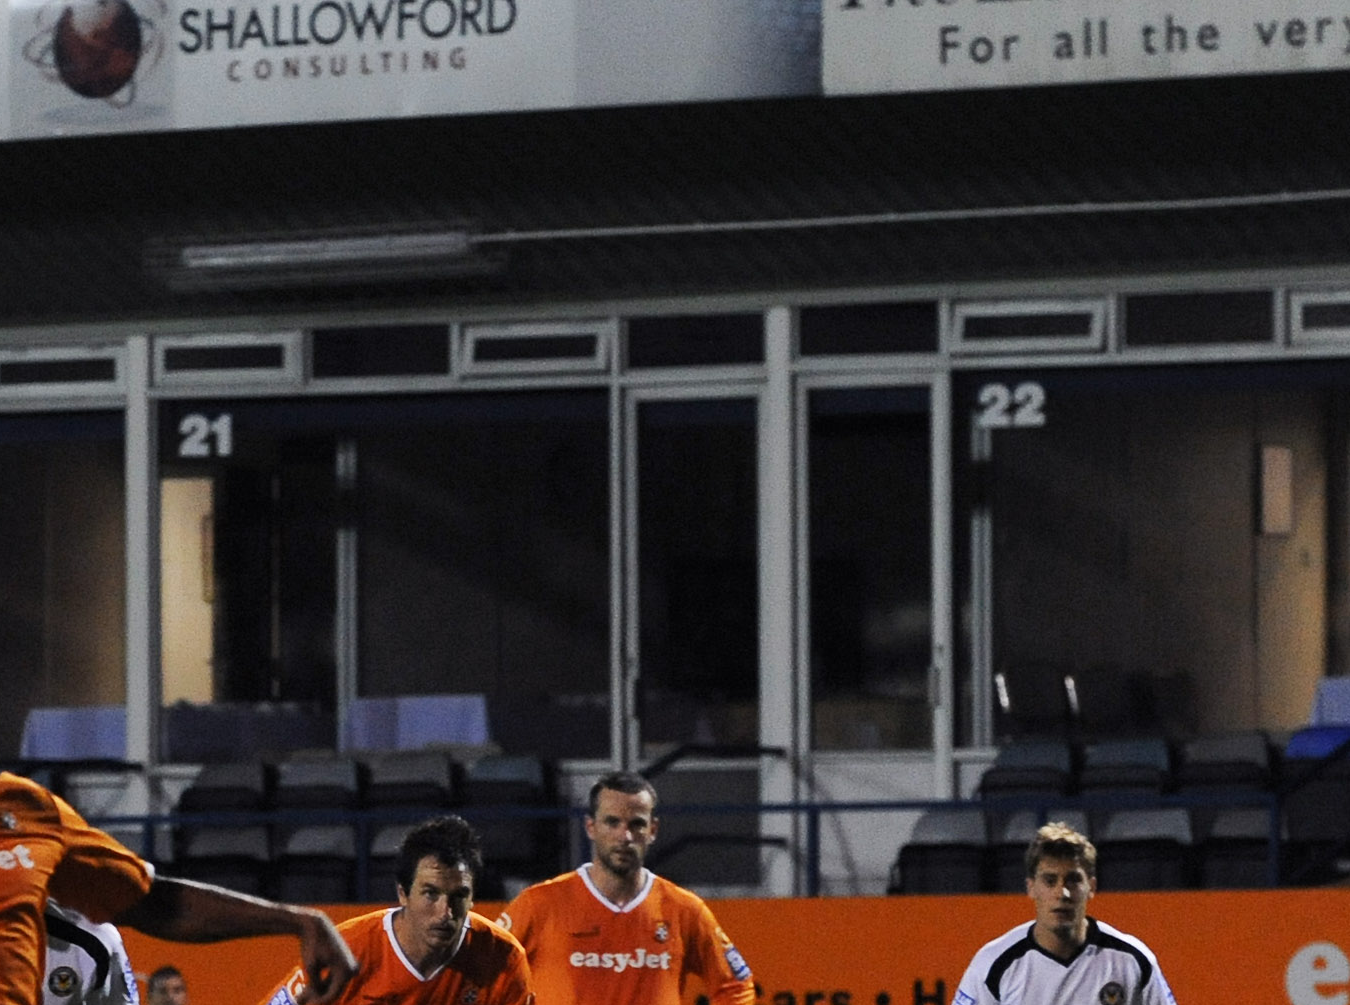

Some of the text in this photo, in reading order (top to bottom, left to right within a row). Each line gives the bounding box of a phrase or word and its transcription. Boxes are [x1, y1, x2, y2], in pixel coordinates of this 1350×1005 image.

[179, 0, 517, 53] SHALLOWFORD
[938, 25, 1019, 65] For
[1054, 18, 1109, 59] all
[1142, 15, 1220, 54] the
[227, 47, 467, 82] CONSULTING
[978, 382, 1046, 427] 22
[178, 413, 233, 457] 21
[570, 948, 671, 973] easyJet
